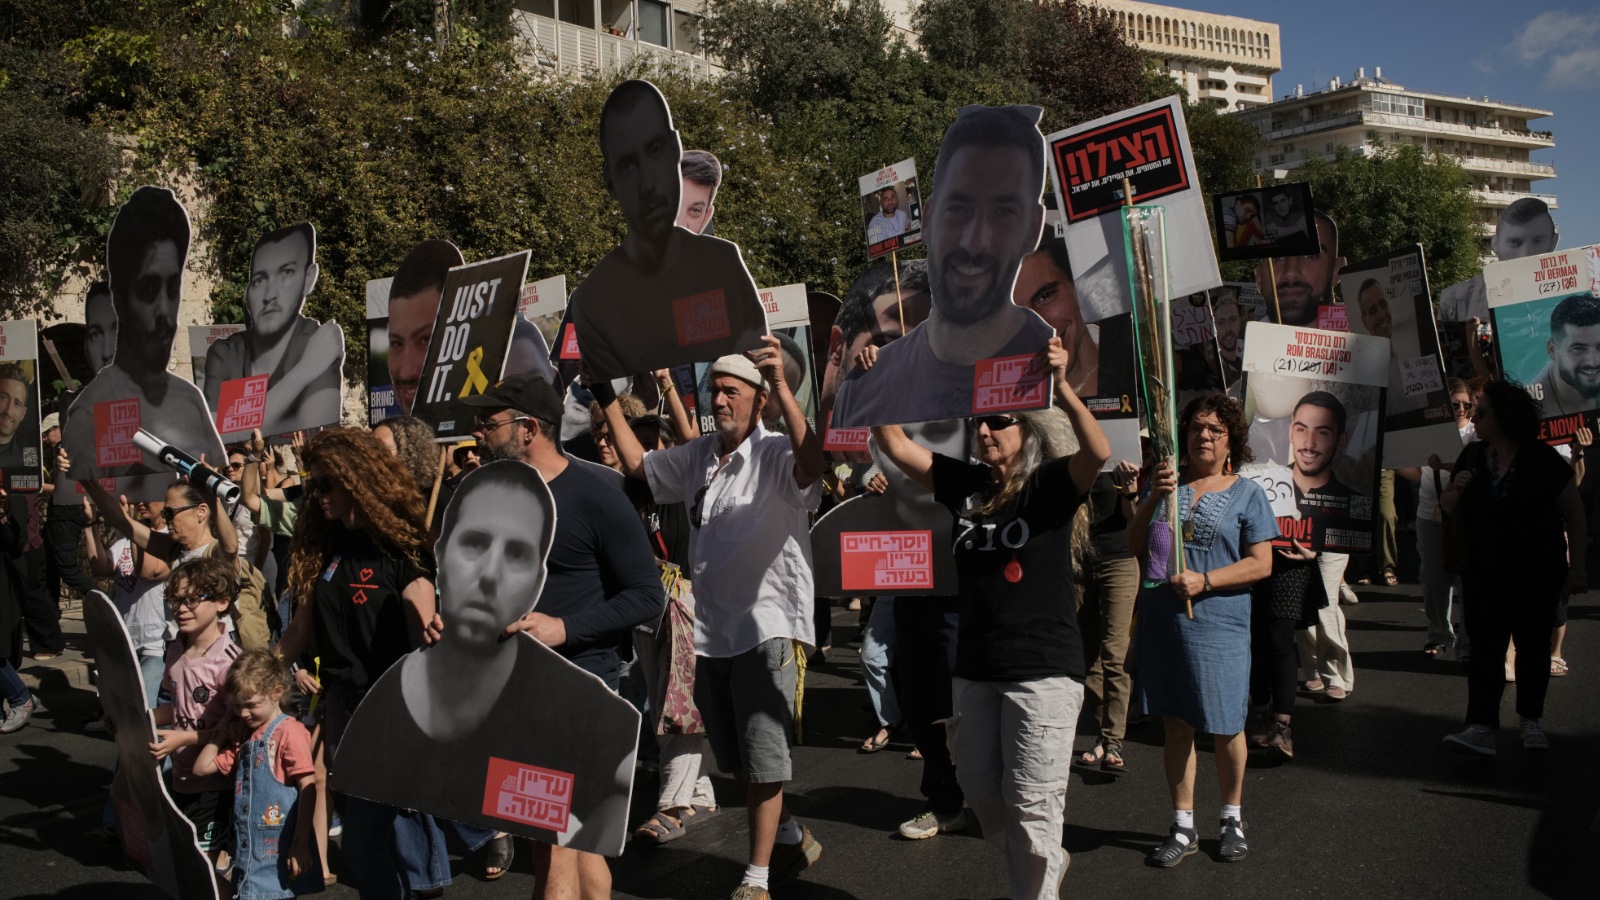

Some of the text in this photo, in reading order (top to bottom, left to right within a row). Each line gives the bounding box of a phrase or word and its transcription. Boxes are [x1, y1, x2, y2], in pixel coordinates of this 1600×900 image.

[1065, 124, 1170, 186] הצילו!
[1162, 157, 1172, 166] את
[1125, 170, 1135, 178] את
[1091, 178, 1101, 188] את
[1540, 254, 1569, 270] זיו ברמן
[1534, 264, 1578, 282] ZIV BERMAN
[1538, 280, 1561, 295] (27)
[446, 278, 502, 324] JUST
[1330, 307, 1347, 318] דיין
[1322, 320, 1348, 329] עזה.
[437, 323, 470, 363] DO
[1295, 331, 1346, 349] רום ברסלבסקי
[1287, 344, 1352, 363] ROM BRASLAVSKI
[1273, 357, 1297, 373] (21)
[247, 381, 265, 393] בר
[426, 364, 453, 404] IT.
[370, 390, 394, 407] BRING
[982, 384, 1041, 406] בעזה.
[235, 395, 265, 414] עדיין
[113, 404, 137, 423] מתן
[226, 413, 262, 429] בעזה.
[370, 408, 386, 424] HIM
[1549, 412, 1586, 438] NOW!
[110, 424, 139, 444] עדיין
[831, 431, 868, 443] בעזה.
[105, 446, 140, 462] בעזה.
[953, 517, 1030, 555] 7.10
[1276, 516, 1313, 540] NOW!
[845, 535, 926, 551] יוסף-חיים
[1325, 535, 1351, 547] FAMILIES
[889, 552, 927, 568] עדיין
[881, 571, 928, 583] בעזה.
[520, 770, 568, 797] עדיין
[504, 796, 564, 825] בעזה.
